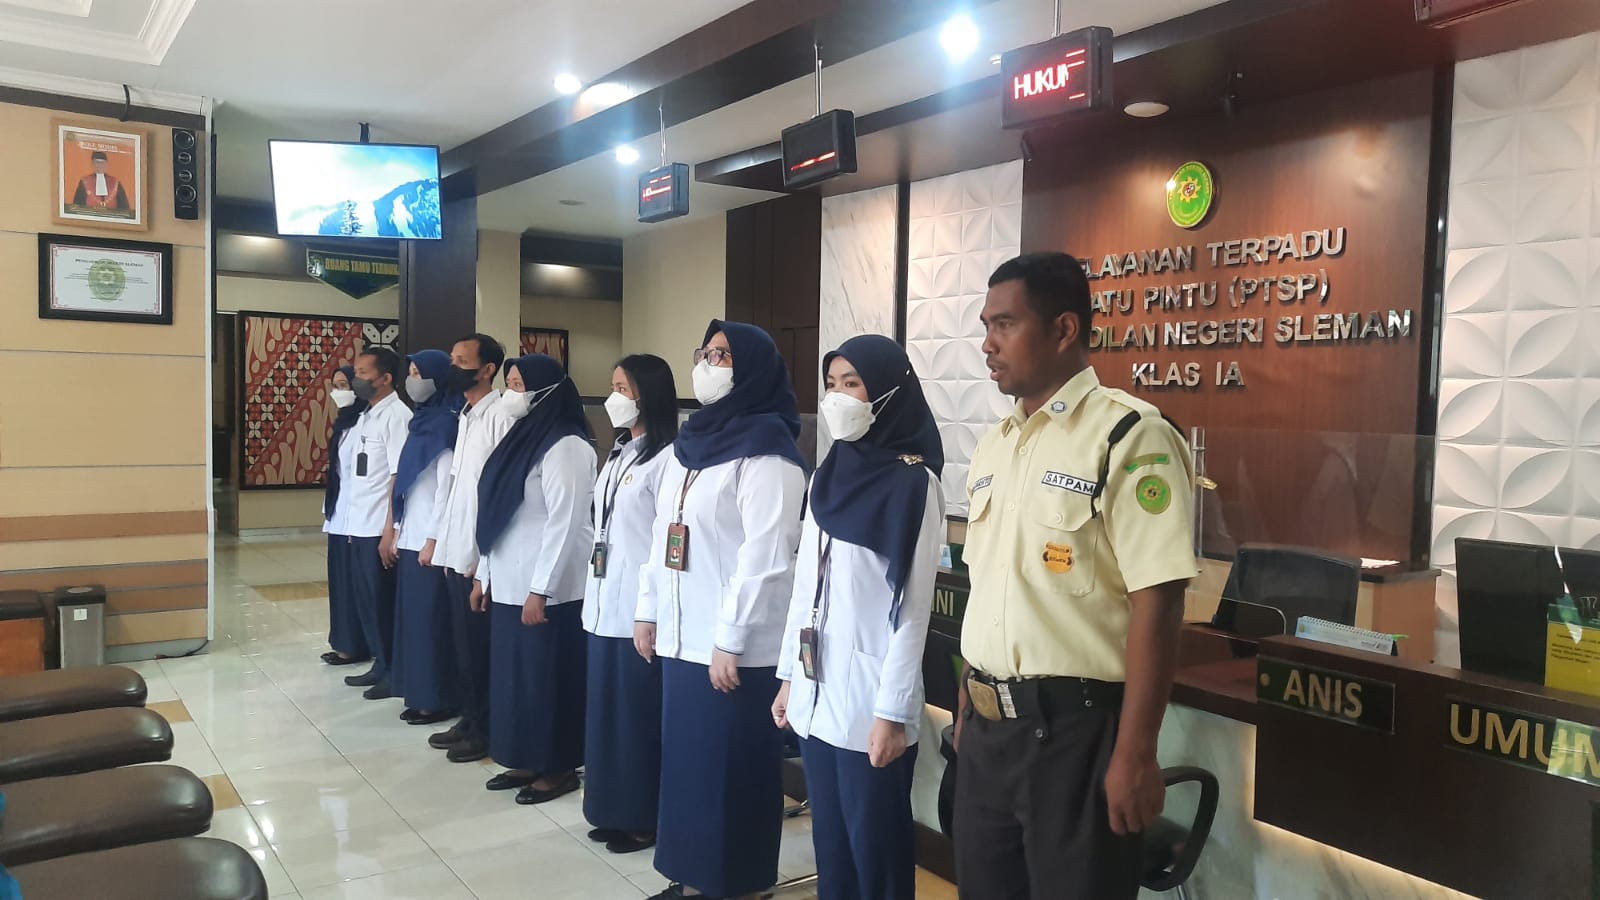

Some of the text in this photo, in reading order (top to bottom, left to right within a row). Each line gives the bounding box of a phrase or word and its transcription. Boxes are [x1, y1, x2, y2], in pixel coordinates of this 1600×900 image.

[1207, 227, 1347, 267] TERPADU
[351, 260, 370, 273] TAMU
[1144, 280, 1217, 310] PINTU
[1229, 269, 1329, 308] (PTSP)
[1164, 316, 1264, 345] NEGERI
[1274, 309, 1412, 342] SLEMAN
[1131, 361, 1245, 386] KLAS IA
[1045, 473, 1094, 494] SATPAM
[931, 588, 954, 617] NI
[1282, 668, 1363, 720] ANIS
